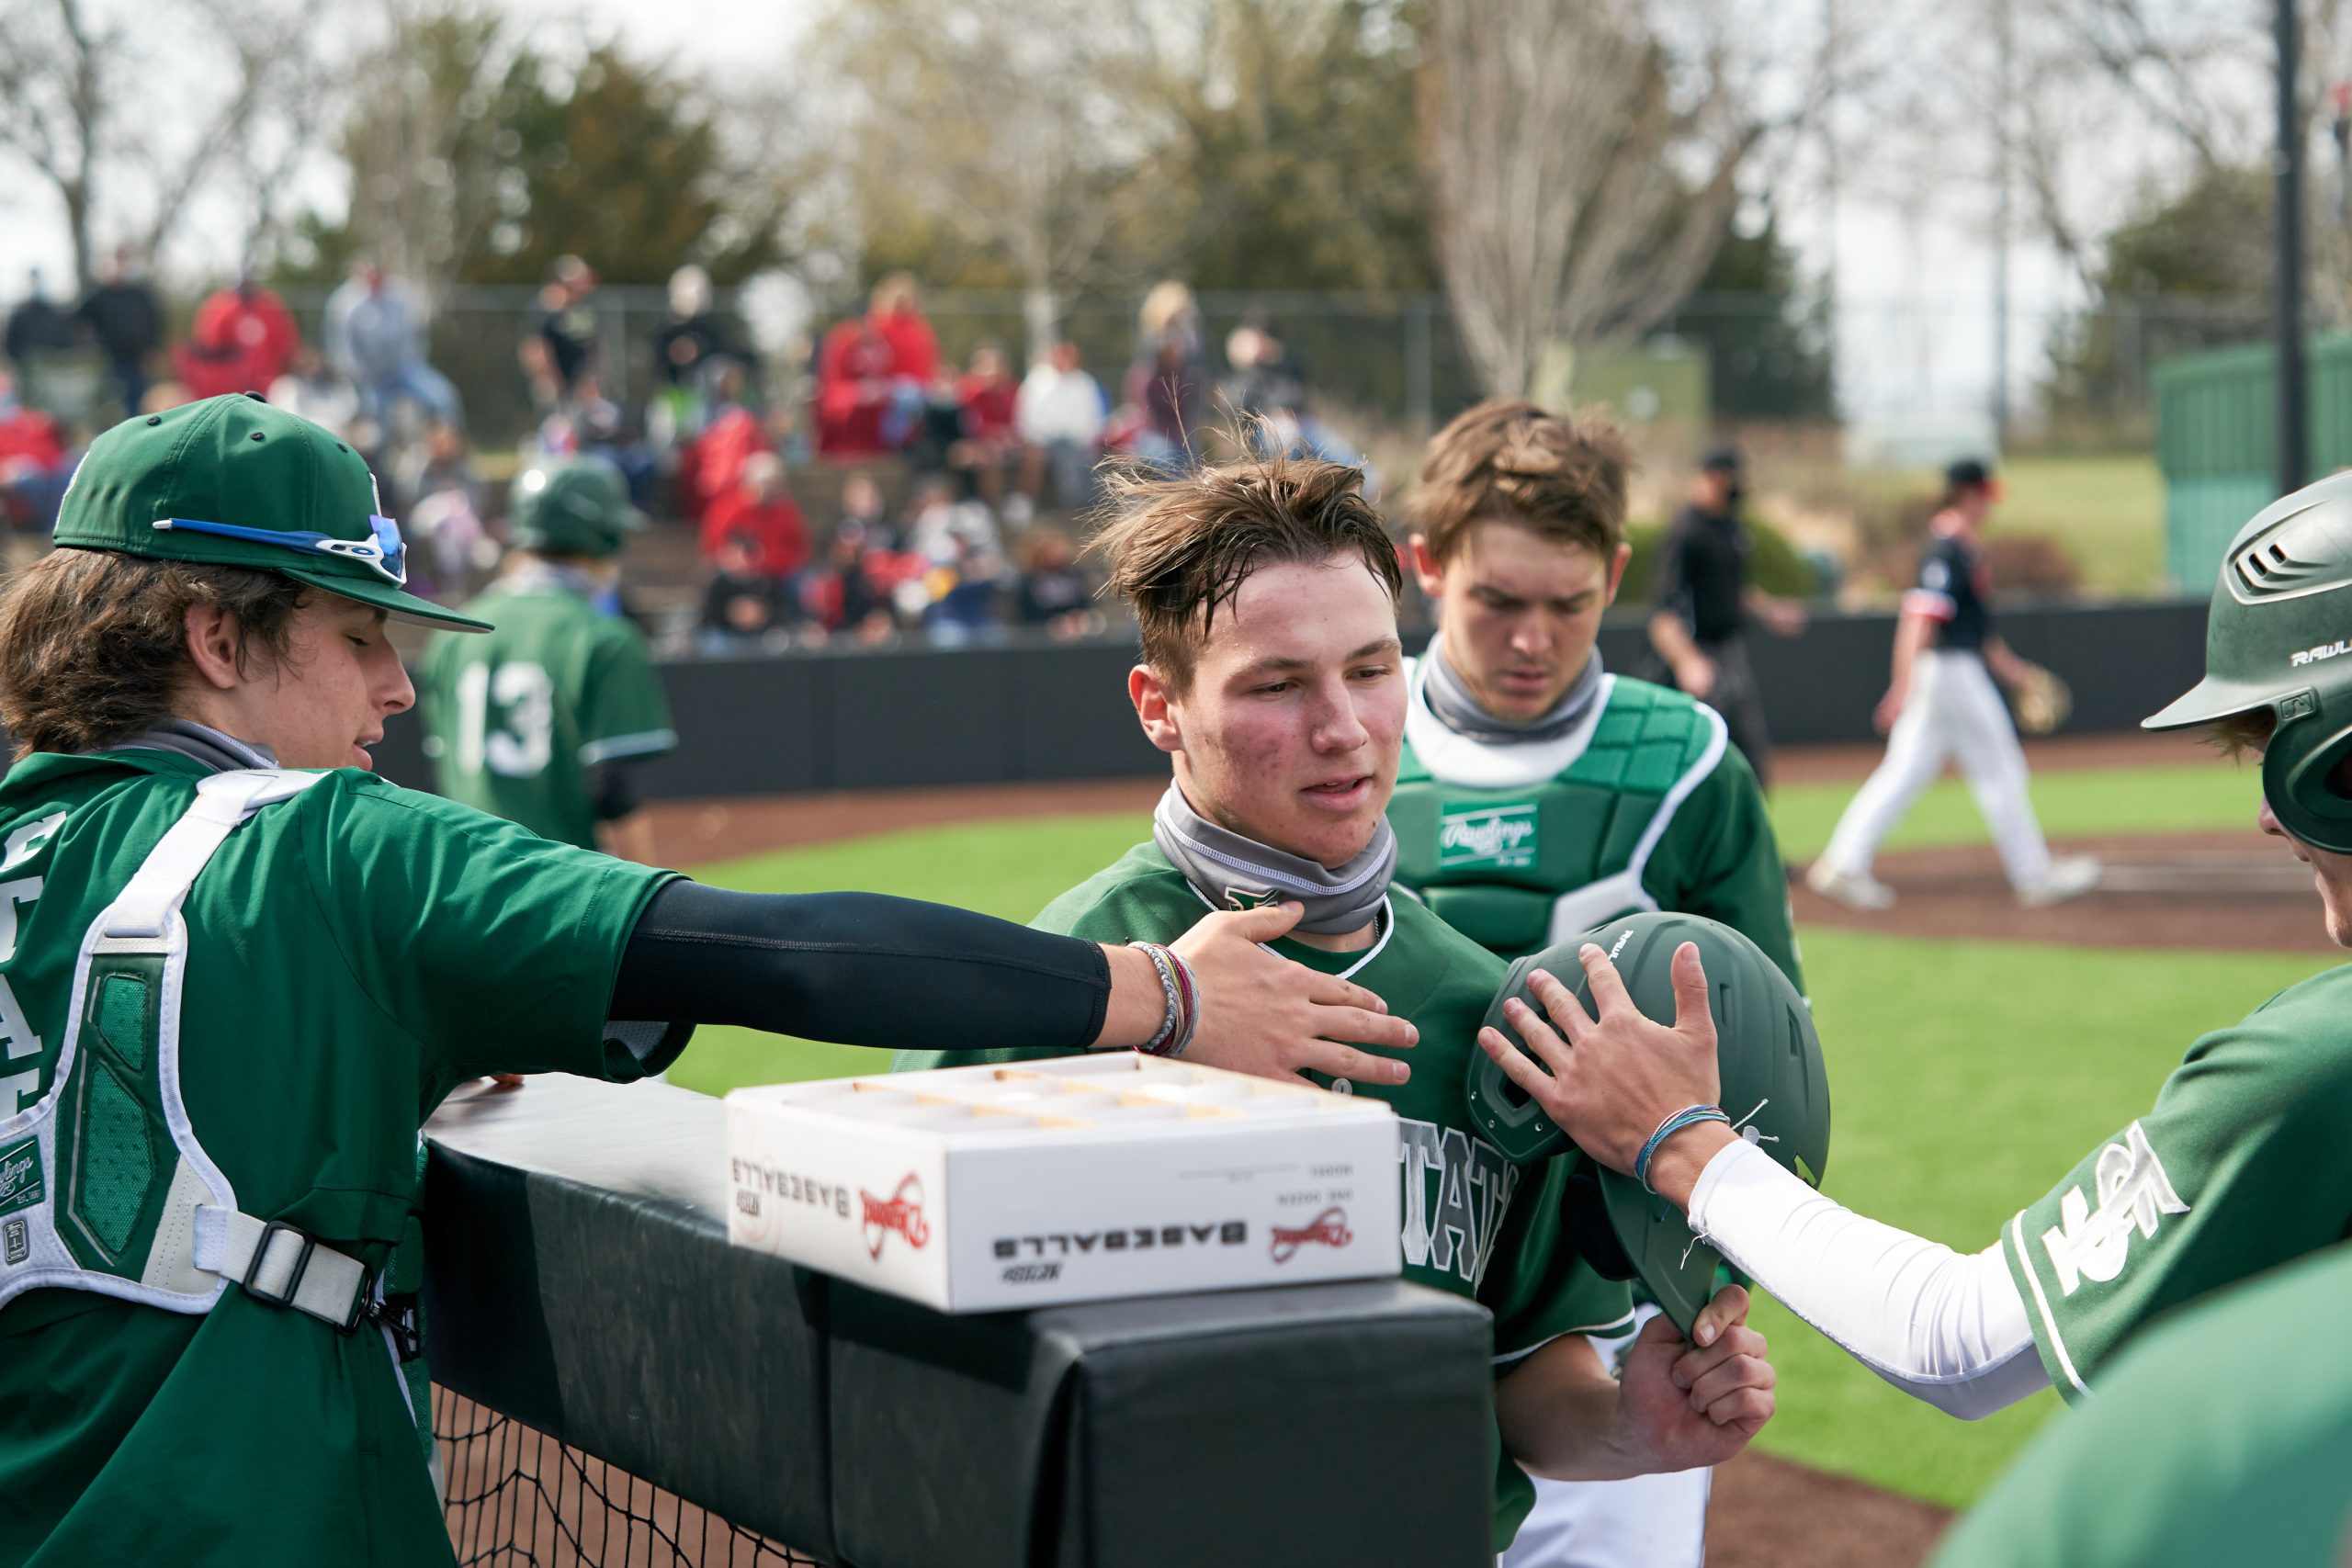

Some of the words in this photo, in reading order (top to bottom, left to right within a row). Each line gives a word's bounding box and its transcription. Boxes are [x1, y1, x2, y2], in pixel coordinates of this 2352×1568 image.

[2290, 639, 2352, 667] RAWL
[457, 660, 553, 777] 13
[994, 1221, 1247, 1258] BASEBALLS
